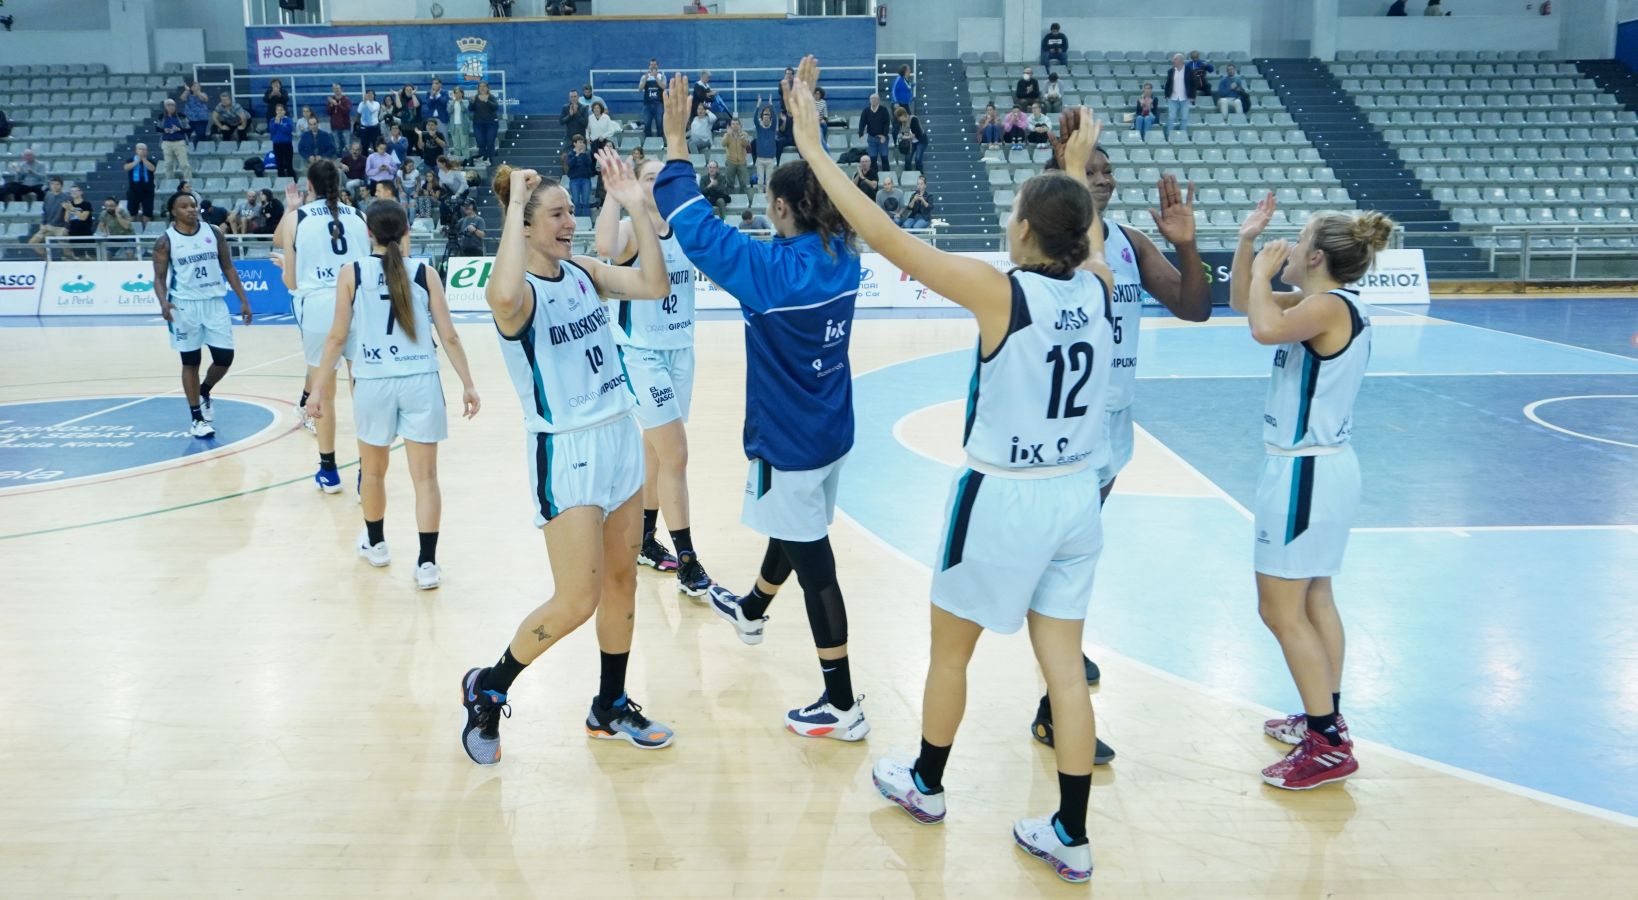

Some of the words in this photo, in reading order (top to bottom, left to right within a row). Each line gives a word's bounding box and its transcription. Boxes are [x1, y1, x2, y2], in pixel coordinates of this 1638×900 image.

[262, 42, 383, 59] #GoazenNeskak
[310, 206, 351, 216] SORNO
[328, 220, 348, 255] 8
[194, 266, 208, 279] 24
[237, 270, 262, 279] RAIN
[0, 275, 36, 286] ASCO
[225, 281, 269, 291] KOLA
[1357, 273, 1420, 287] URRIOZ
[662, 294, 678, 314] 42
[549, 324, 571, 345] IDK
[1046, 341, 1094, 419] 12
[652, 386, 672, 399] DIARIO
[655, 392, 675, 404] VASCO
[0, 432, 39, 440] AN
